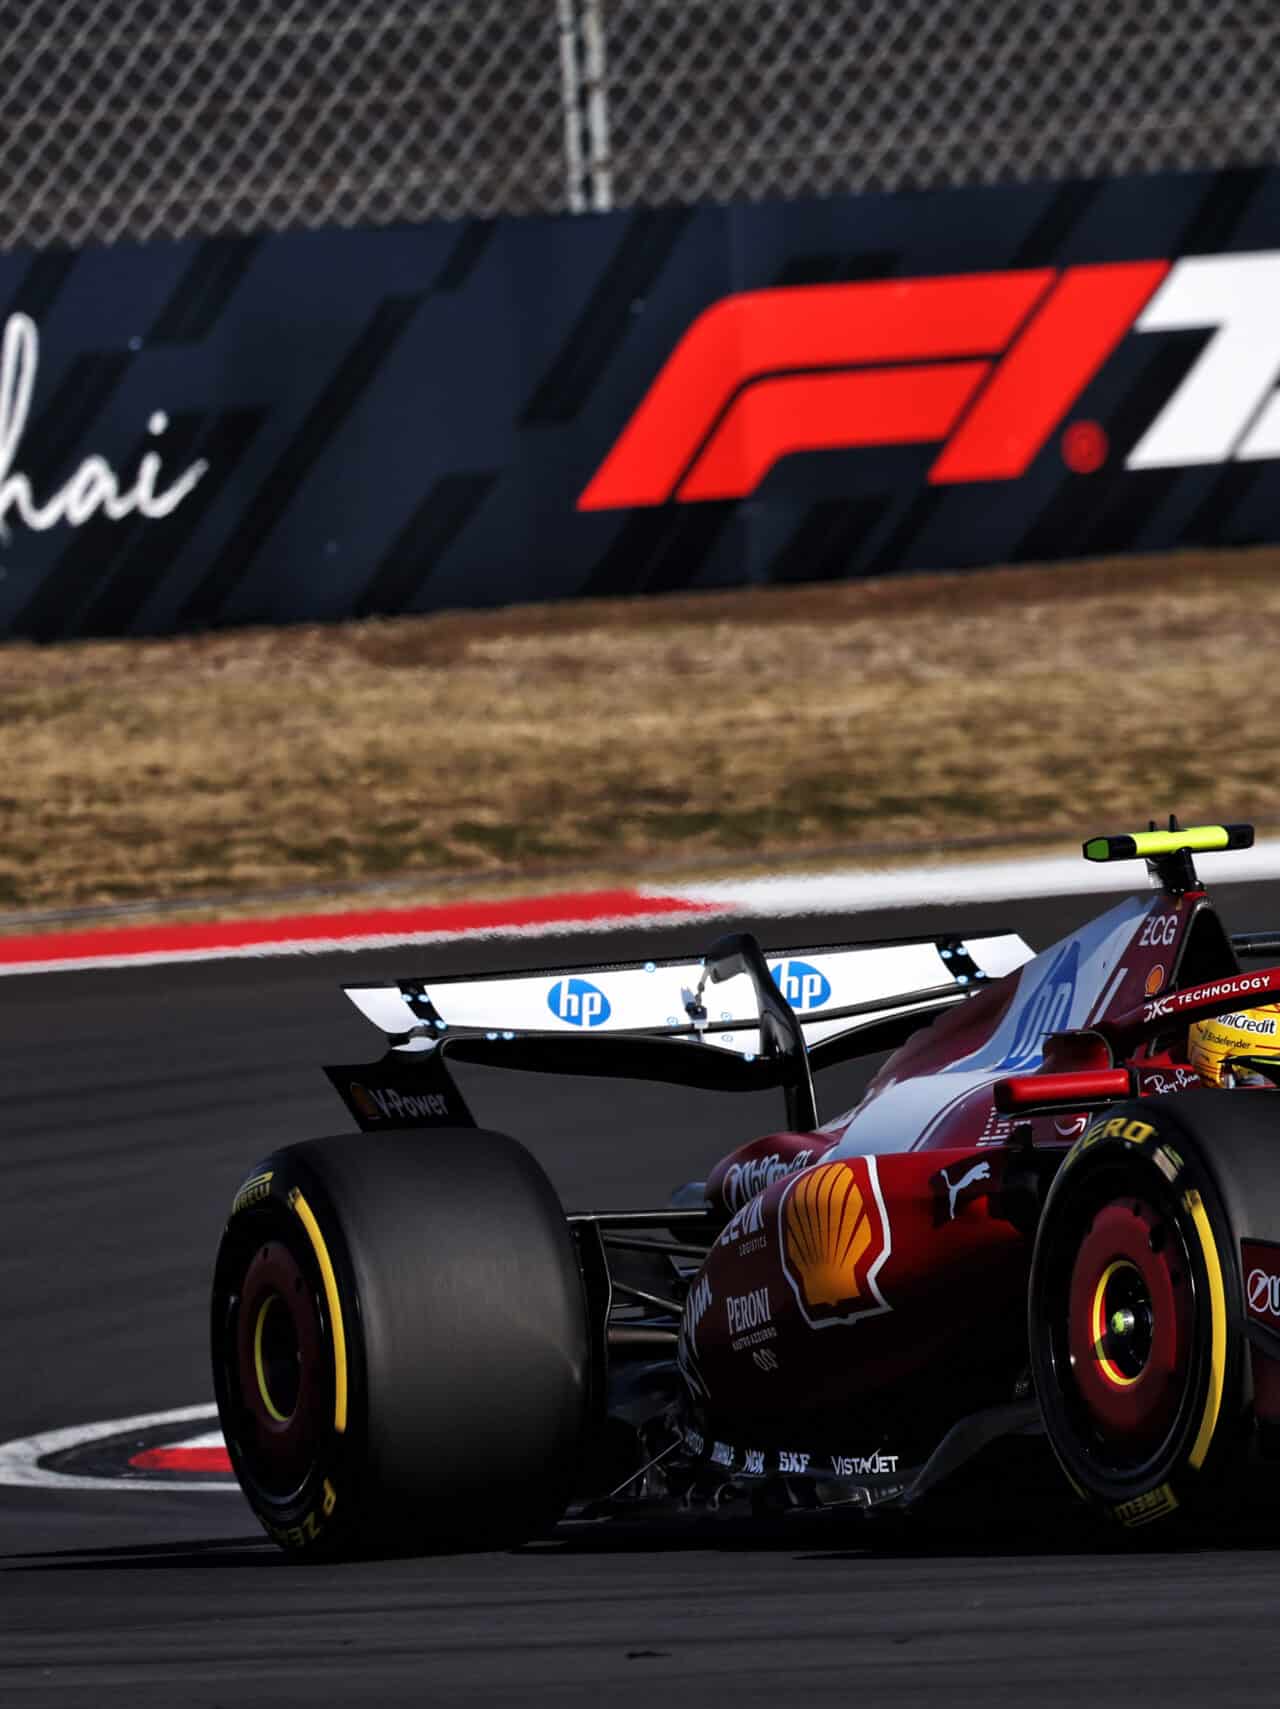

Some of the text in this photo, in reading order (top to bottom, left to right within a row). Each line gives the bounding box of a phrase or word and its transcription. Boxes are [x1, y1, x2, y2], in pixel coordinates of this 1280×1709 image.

[555, 979, 605, 1027] hp
[777, 961, 825, 1009] hp
[1178, 976, 1271, 1005] TECHNOLOGY
[726, 1287, 771, 1336] PERONI
[777, 1450, 812, 1473] SKF
